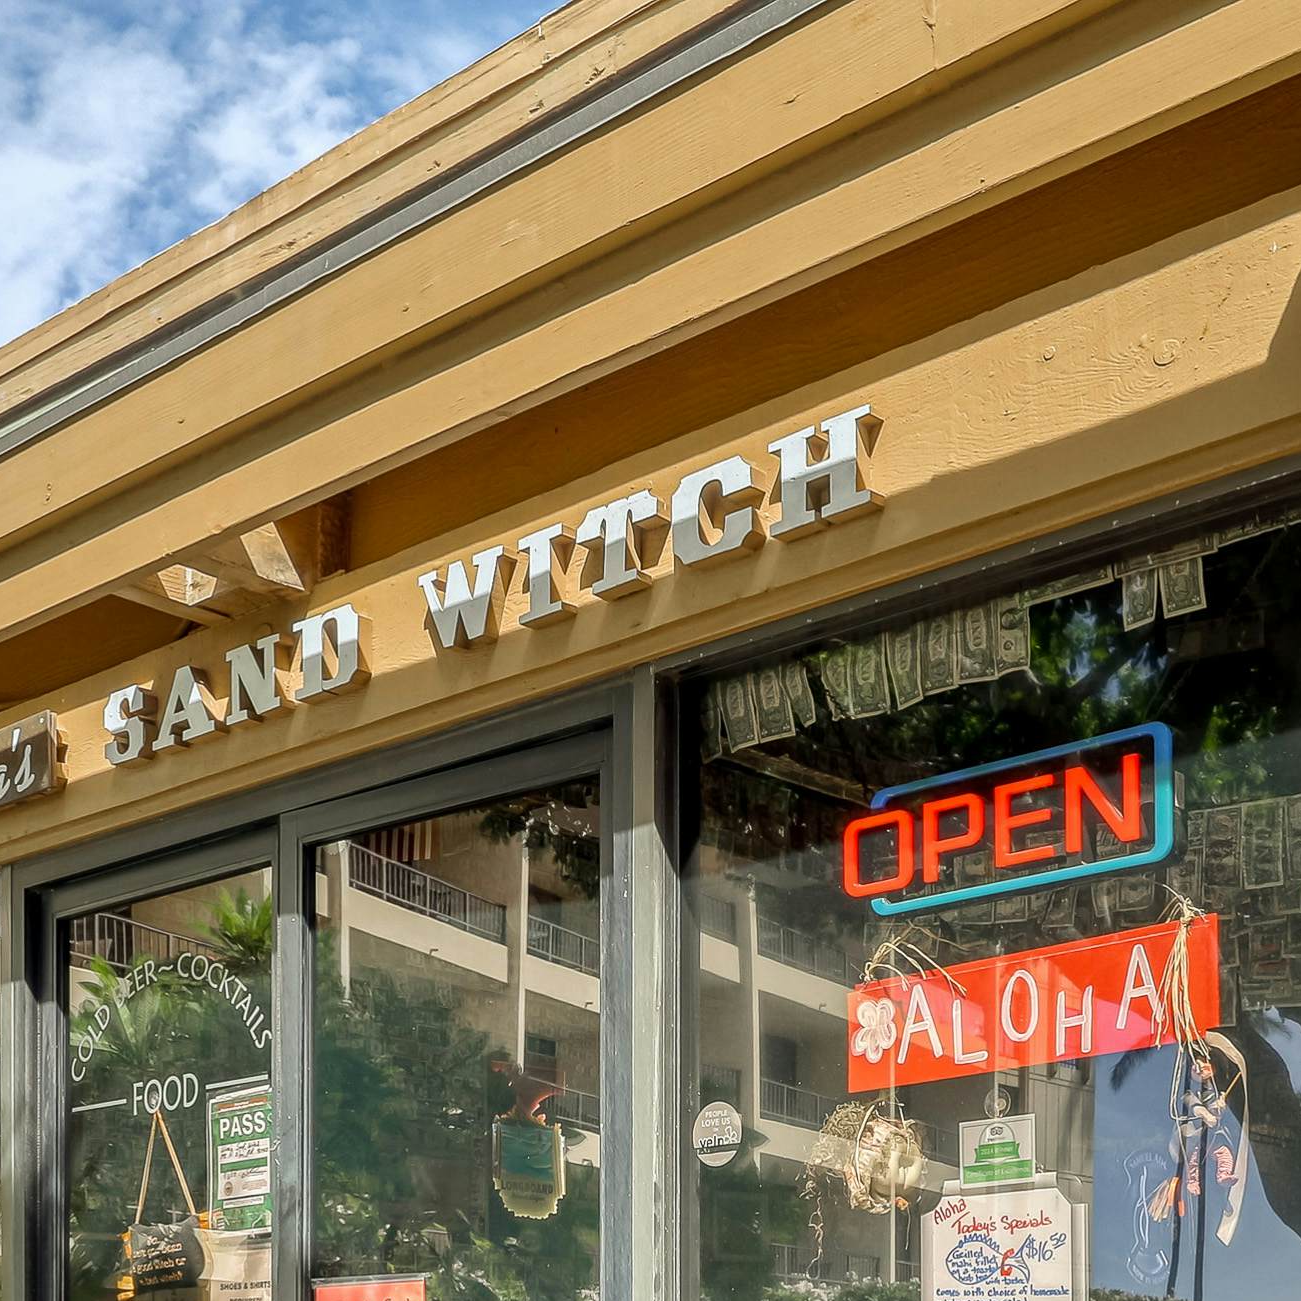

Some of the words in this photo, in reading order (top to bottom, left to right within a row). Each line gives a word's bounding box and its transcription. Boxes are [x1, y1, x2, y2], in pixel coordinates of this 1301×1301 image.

[104, 602, 361, 765] SAND
[417, 403, 874, 649] WITCH
[843, 752, 1141, 898] OPEN
[896, 943, 1163, 1066] ALOHA
[71, 1004, 111, 1082] COLD
[133, 1072, 199, 1116] FOOD
[219, 1110, 266, 1139] PASS
[701, 1118, 719, 1127] LOVE
[721, 1117, 731, 1125] US
[705, 1109, 728, 1118] PEOPLE
[934, 1198, 967, 1224] Aloha
[951, 1212, 996, 1236] Today's
[1000, 1210, 1052, 1234] Specials
[952, 1247, 983, 1259] Grilled
[220, 1282, 242, 1291] SHOES
[249, 1280, 271, 1290] SHIRTS
[936, 1288, 960, 1297] comes
[963, 1284, 984, 1297] with
[987, 1286, 1016, 1297] choice
[1018, 1285, 1028, 1295] of
[1029, 1284, 1069, 1297] homemade
